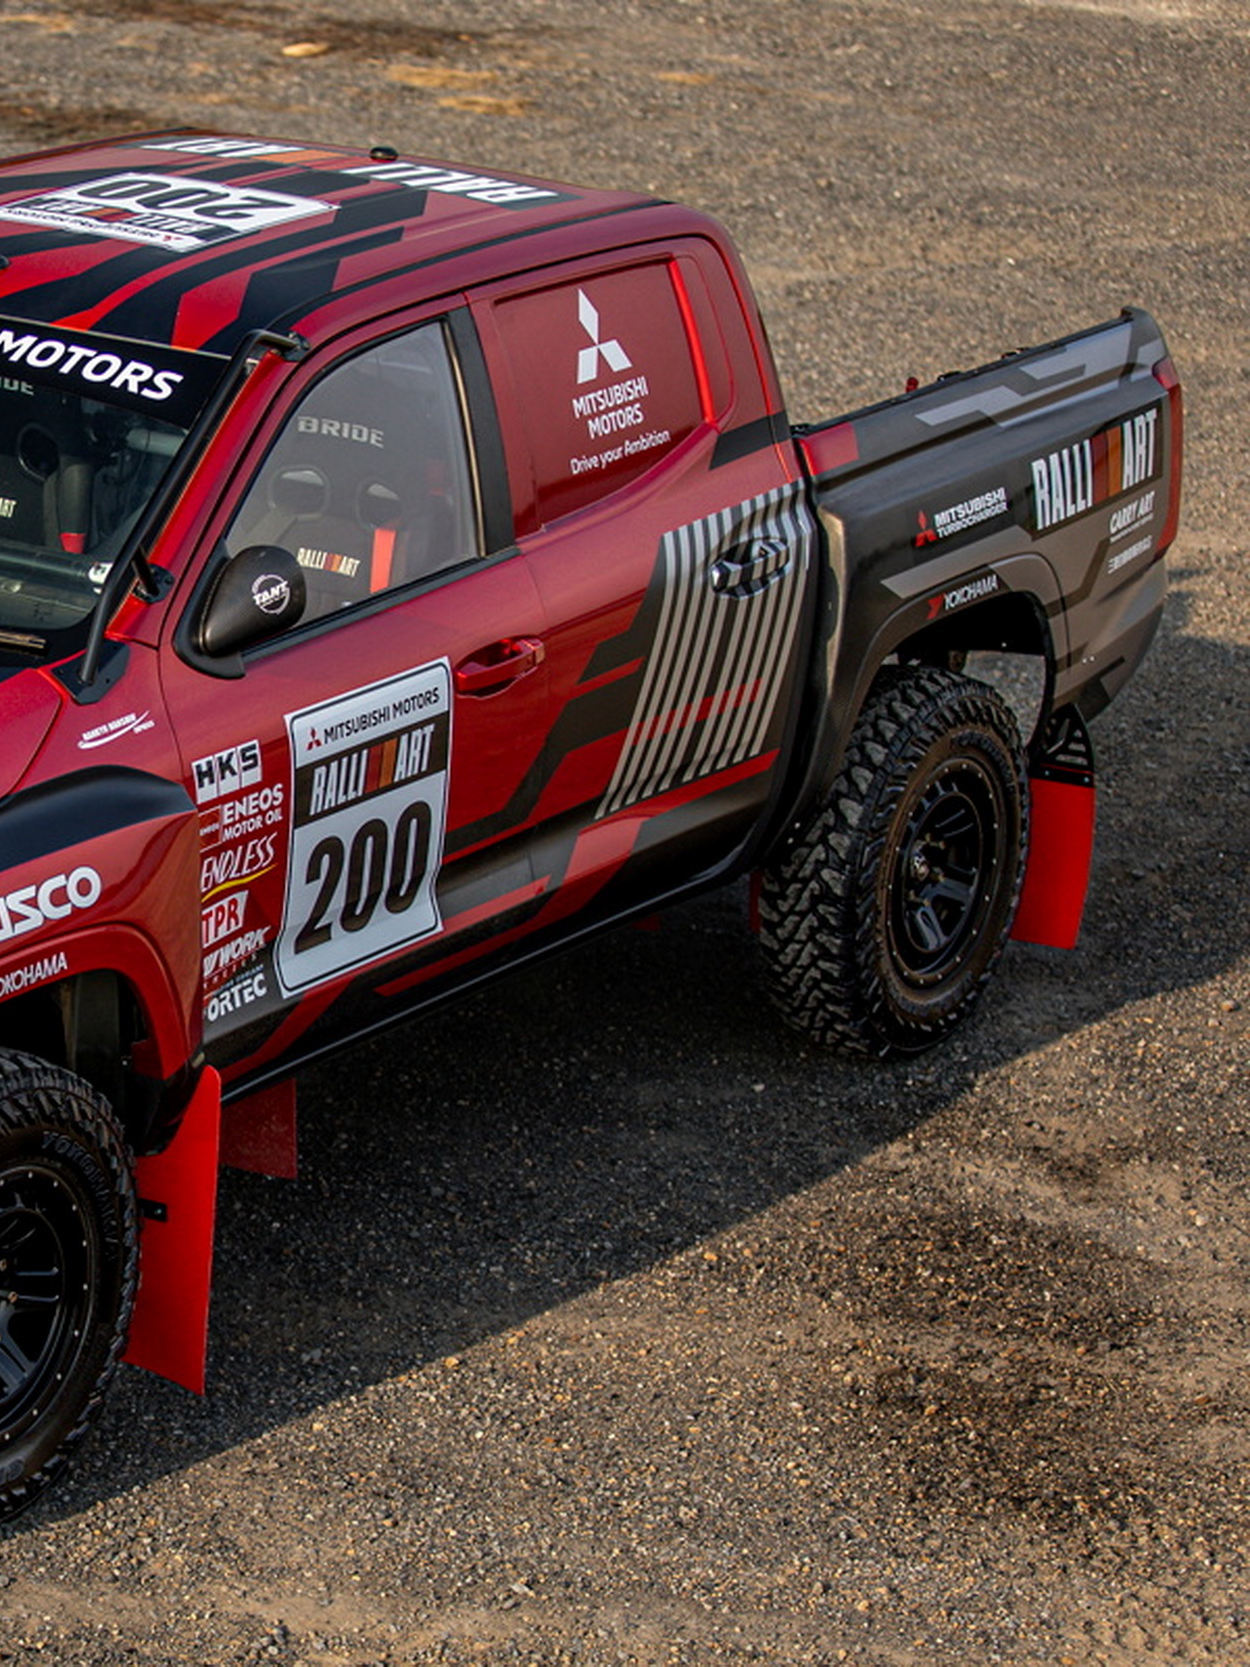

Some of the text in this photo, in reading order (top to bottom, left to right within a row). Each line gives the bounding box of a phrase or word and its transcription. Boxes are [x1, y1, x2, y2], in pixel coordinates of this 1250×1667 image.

[77, 179, 296, 219] 200
[572, 376, 649, 418] MITSUBISHI
[298, 416, 384, 448] BRIDE
[587, 404, 644, 439] MOTORS
[570, 430, 671, 475] Drive your Ambition
[934, 487, 1007, 527] MITSUBISHI
[937, 501, 1009, 539] TURBOCHARGER
[943, 574, 999, 610] YOKOHAMA
[324, 687, 440, 744] MITSUBISHI MOTORS
[195, 743, 259, 788] HKS
[222, 783, 284, 825] ENEOS
[222, 808, 283, 842] MOTOR OIL
[201, 832, 277, 892] ENDLESS
[294, 801, 432, 955] 200
[202, 899, 239, 944] TPR
[203, 973, 267, 1021] ORTEC
